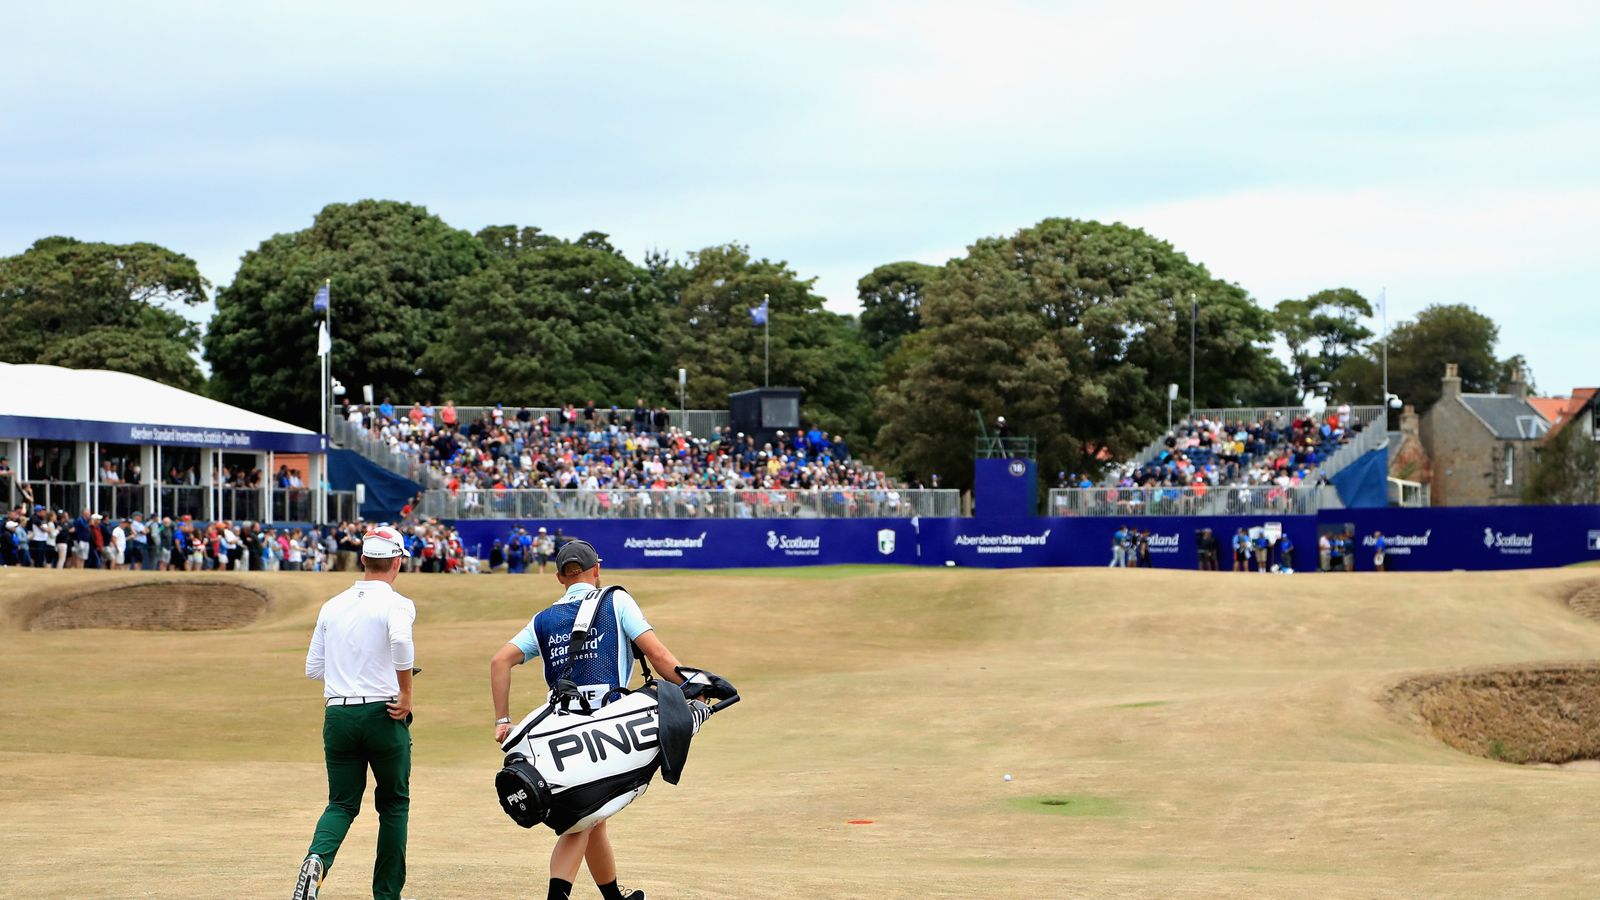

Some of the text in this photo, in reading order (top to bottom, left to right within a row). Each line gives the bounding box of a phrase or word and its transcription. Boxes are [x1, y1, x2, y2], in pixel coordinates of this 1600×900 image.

[131, 426, 153, 440] Aberdeen
[153, 428, 175, 441] Standard
[175, 429, 203, 443] Investments
[222, 432, 233, 447] Open
[1011, 463, 1023, 473] 18
[779, 535, 820, 549] Scotland
[1146, 533, 1180, 546] otland
[1495, 532, 1533, 547] Scotland
[547, 716, 660, 772] PING
[507, 789, 528, 806] PING
